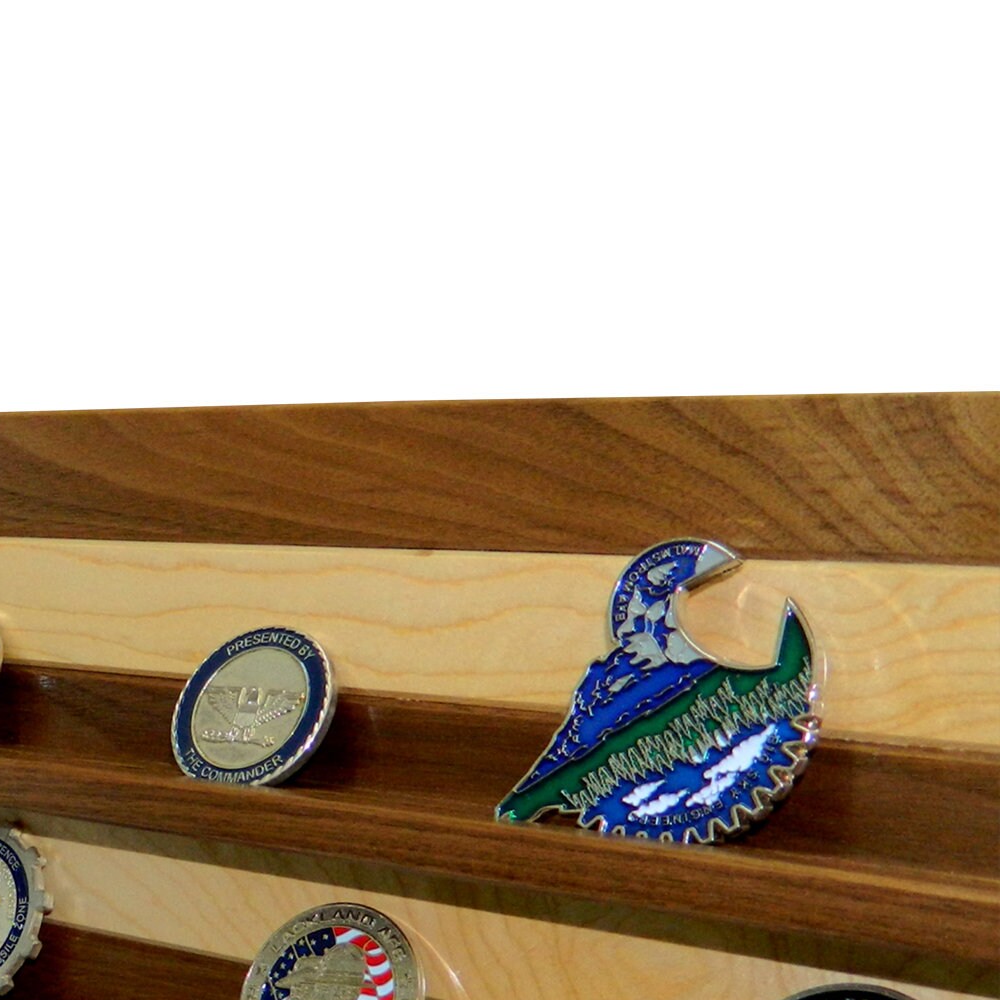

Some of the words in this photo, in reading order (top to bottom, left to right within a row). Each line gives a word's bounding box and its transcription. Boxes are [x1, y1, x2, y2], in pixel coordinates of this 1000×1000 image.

[226, 632, 301, 655] PRESENTED
[298, 645, 316, 660] BY
[185, 748, 203, 771] THE
[201, 754, 284, 783] COMMANDER
[14, 896, 28, 930] ZONE
[271, 909, 377, 953] LACKLAND
